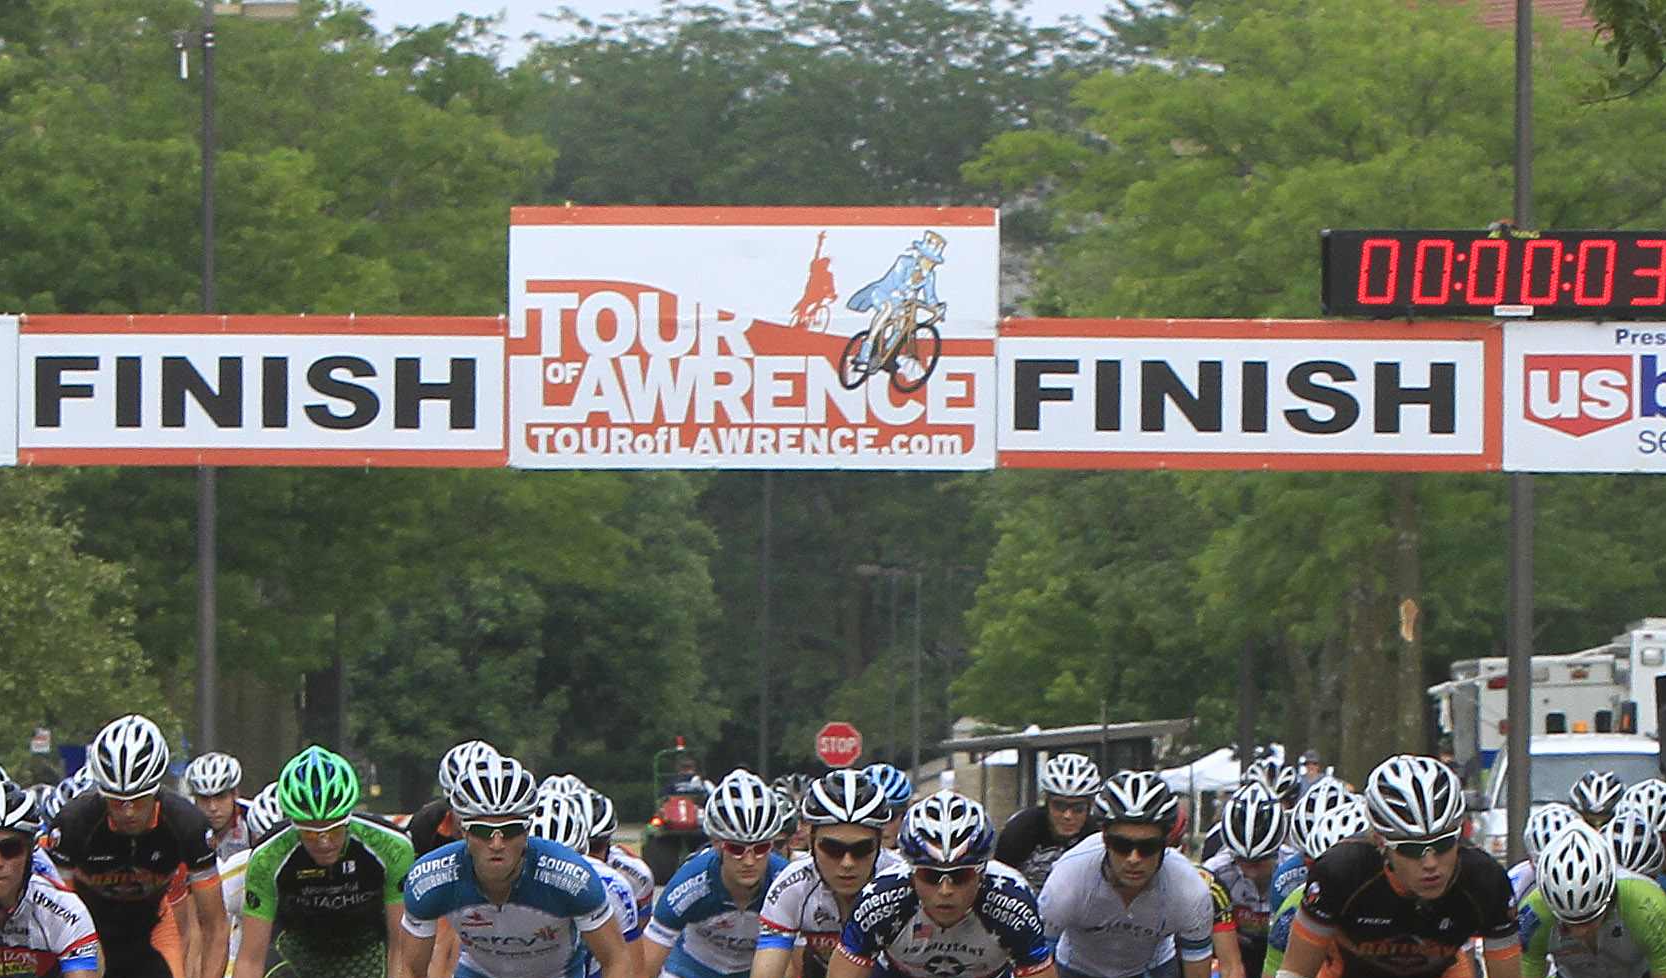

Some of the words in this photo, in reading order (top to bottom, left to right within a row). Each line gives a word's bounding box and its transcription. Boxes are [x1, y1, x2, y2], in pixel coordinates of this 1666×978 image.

[525, 291, 754, 359] TOUR
[545, 360, 582, 386] OF
[34, 355, 477, 431] FINISH
[530, 354, 978, 426] LAWRENCE
[1014, 358, 1456, 434] FINISH
[530, 425, 964, 458] TOURofLAWRENCE.com
[821, 736, 856, 753] STOP
[408, 853, 457, 885] SOURCE
[537, 855, 591, 884] SOURCE
[1274, 865, 1309, 892] SOURC
[33, 890, 80, 928] HORIZON
[981, 901, 1027, 933] classic
[985, 890, 1044, 936] american
